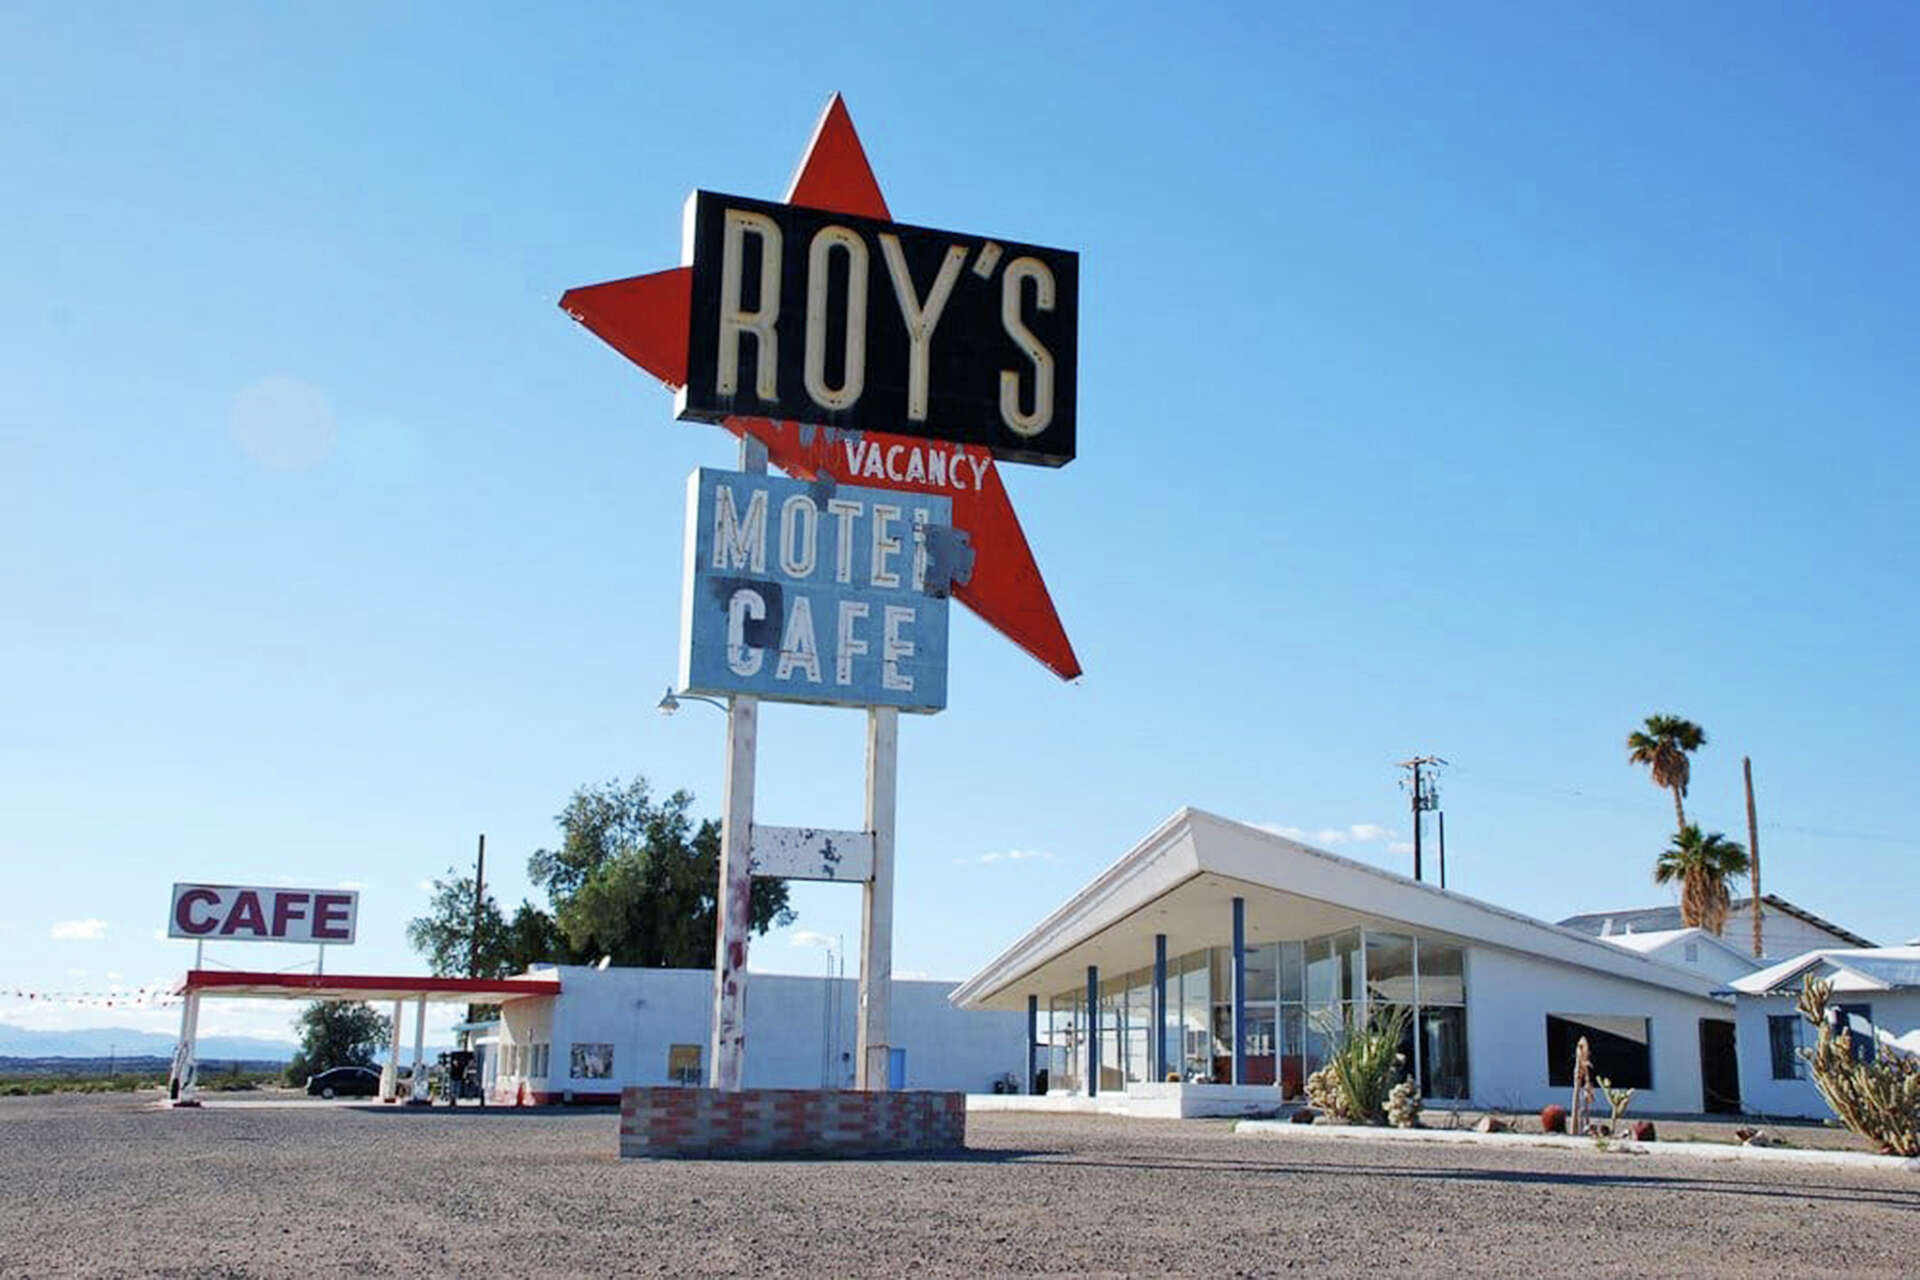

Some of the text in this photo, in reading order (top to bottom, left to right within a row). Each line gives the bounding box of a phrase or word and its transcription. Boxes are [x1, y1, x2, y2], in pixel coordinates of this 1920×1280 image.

[716, 208, 1055, 438] ROY'S
[844, 438, 991, 491] VACANCY
[727, 589, 915, 691] CAFE
[175, 889, 352, 939] CAFE
